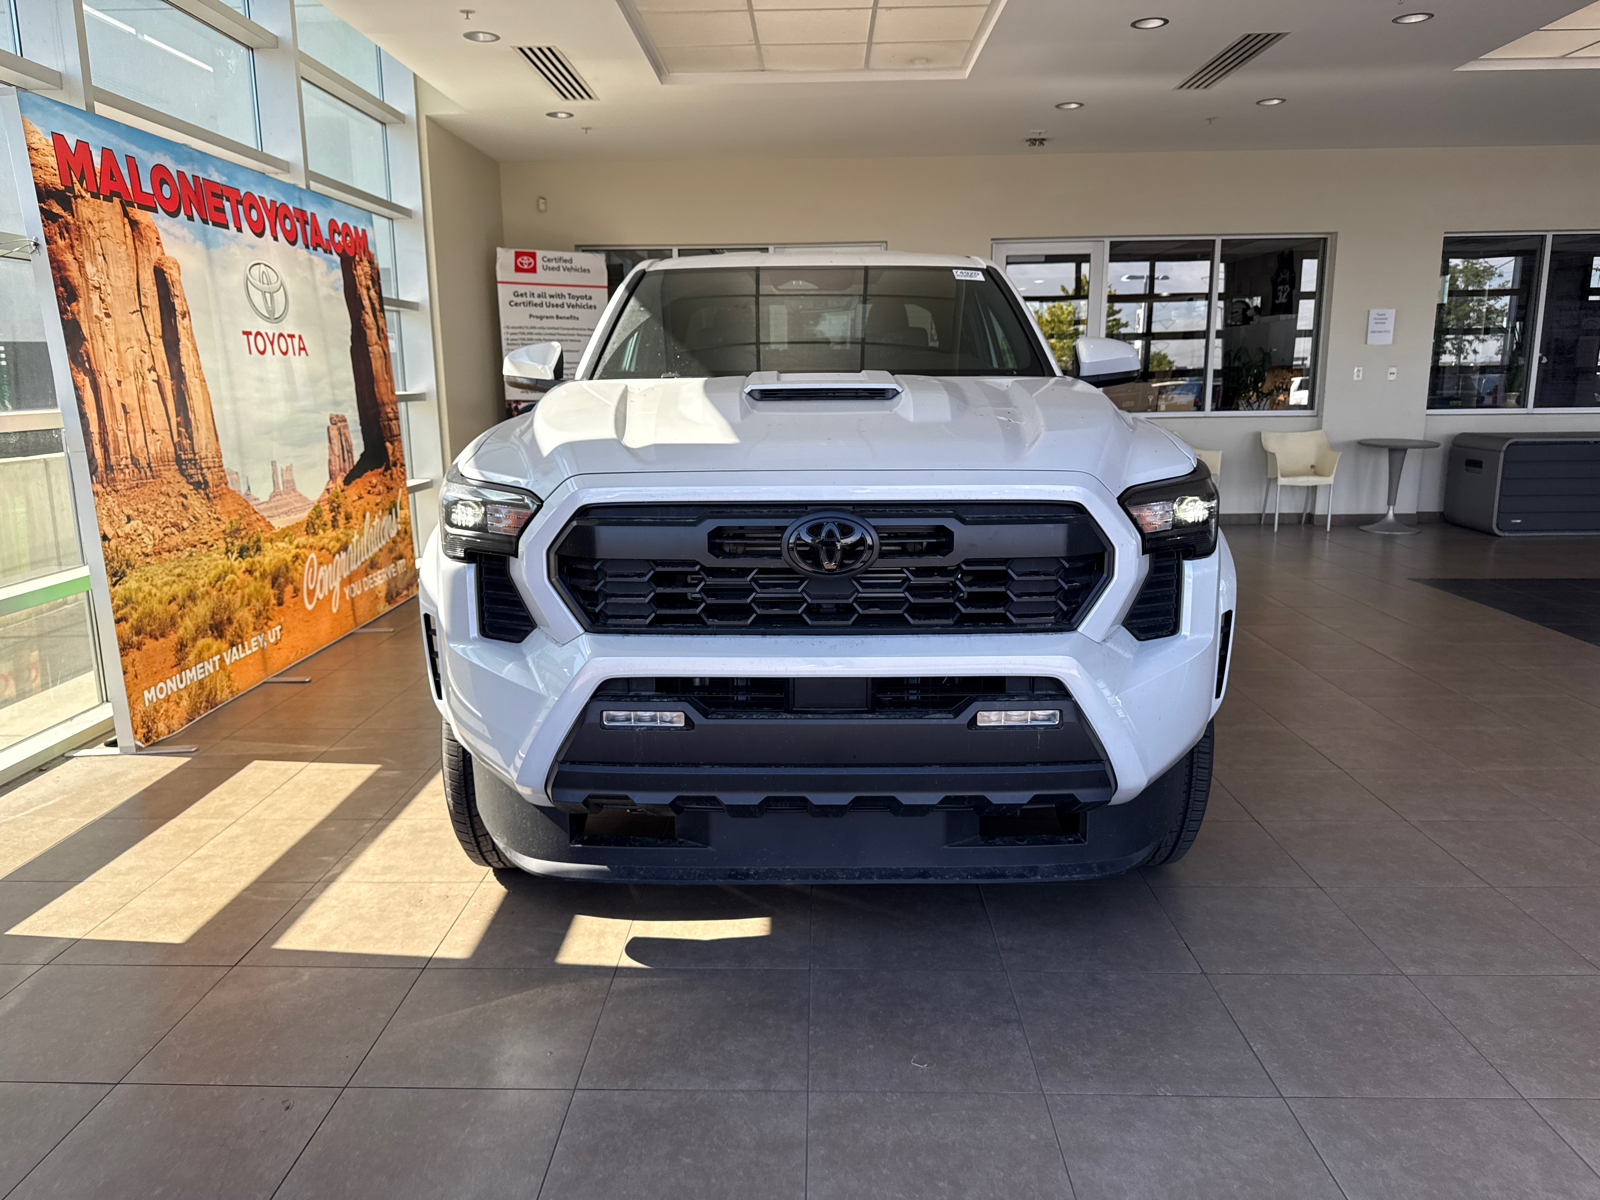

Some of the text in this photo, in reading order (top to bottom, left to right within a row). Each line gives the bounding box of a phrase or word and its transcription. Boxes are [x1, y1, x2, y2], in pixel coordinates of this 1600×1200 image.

[51, 131, 372, 260] MALONETOYOTA.COM
[541, 255, 573, 264] Certified
[562, 265, 591, 274] Vehicles
[513, 290, 593, 302] Get it all with Toyota
[1275, 284, 1291, 304] 32
[509, 300, 544, 309] Certified
[566, 302, 597, 310] Vehicles
[529, 313, 555, 321] Program
[242, 330, 309, 358] TOYOTA
[303, 487, 402, 614] Congratulations!
[343, 558, 407, 600] YOU DESERVE IT!
[142, 624, 283, 707] MONUMENT VALLEY, UT
